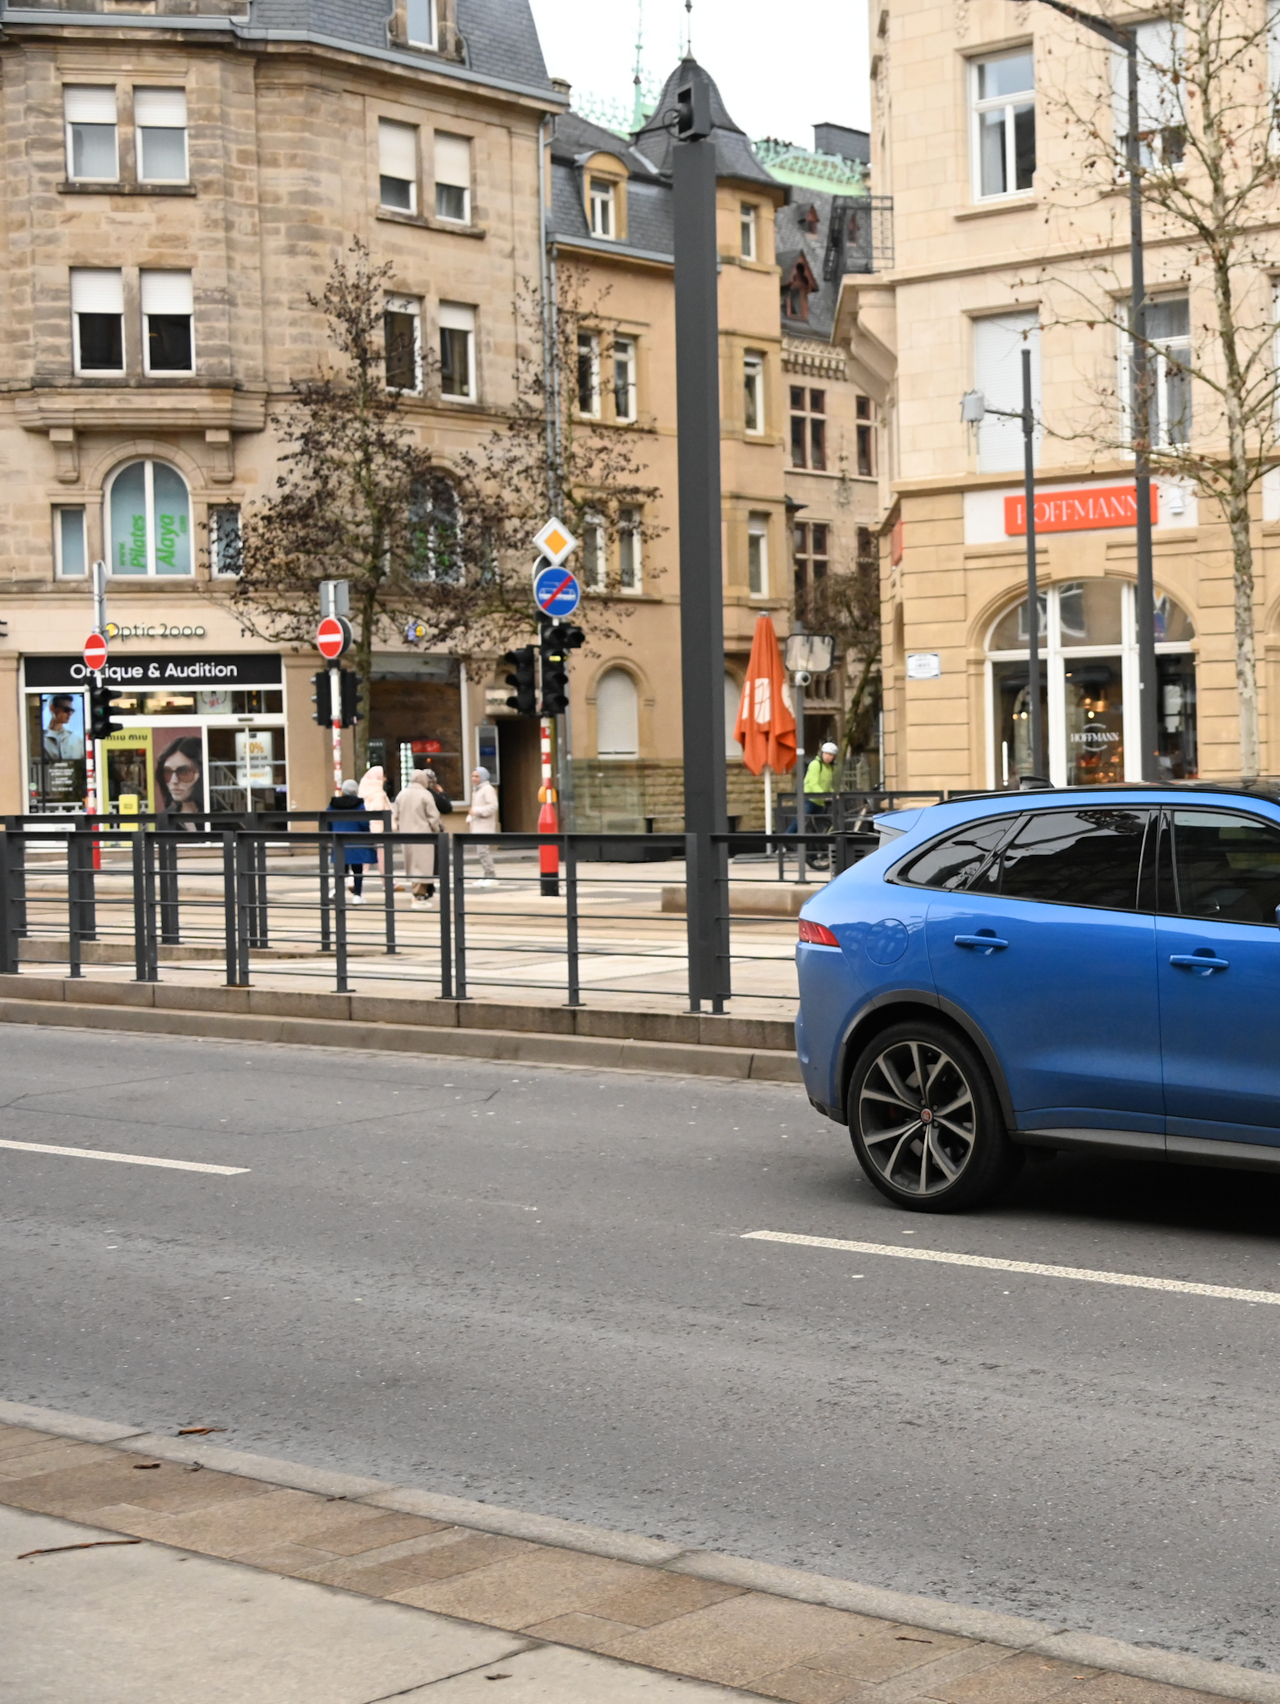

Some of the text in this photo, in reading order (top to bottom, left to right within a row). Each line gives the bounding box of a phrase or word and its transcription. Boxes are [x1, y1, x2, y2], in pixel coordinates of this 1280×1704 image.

[1016, 494, 1138, 525] HOFFMANN
[129, 514, 146, 568] Pilates
[156, 513, 179, 567] Alaya
[105, 622, 207, 643] Optic 2000
[70, 661, 238, 682] Oique & Audition
[128, 733, 148, 741] miu
[1070, 732, 1120, 742] HOFFMANN
